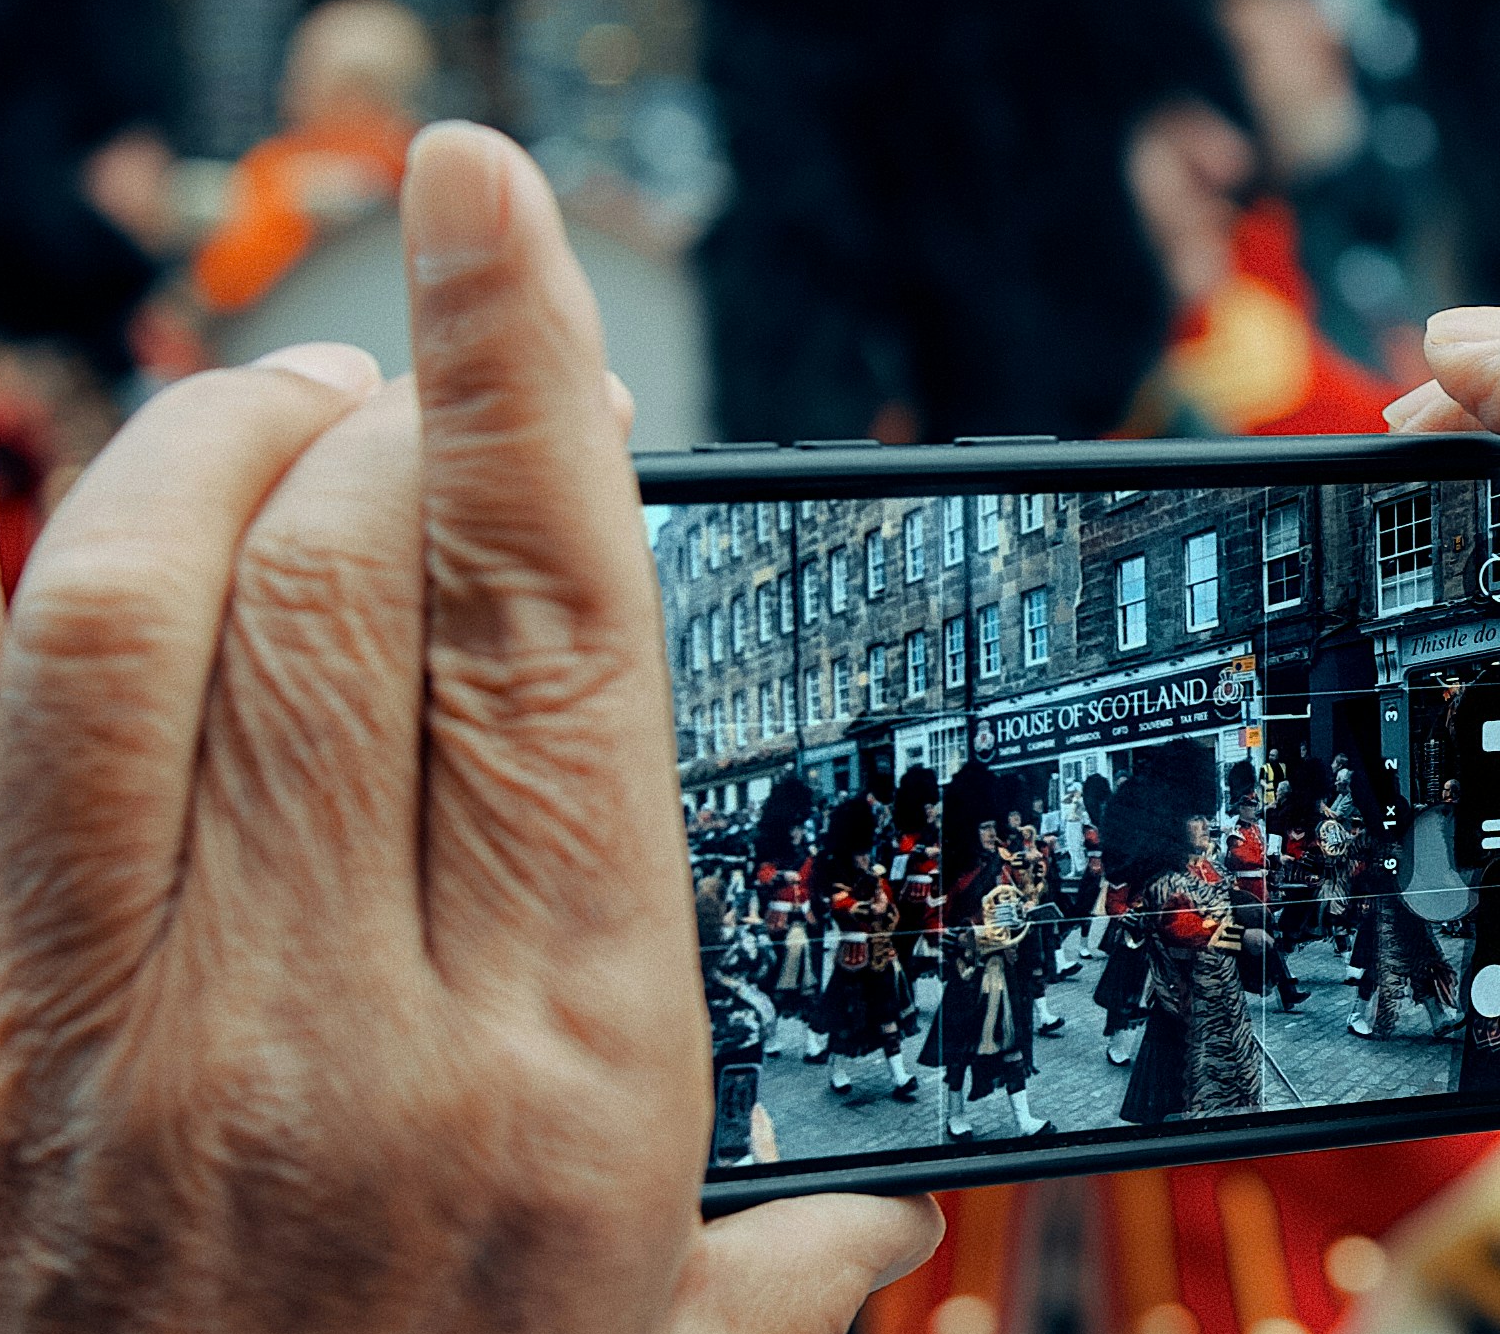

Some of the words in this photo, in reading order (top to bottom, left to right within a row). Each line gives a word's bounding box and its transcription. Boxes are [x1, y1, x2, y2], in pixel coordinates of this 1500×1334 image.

[1411, 629, 1467, 656] Thistle
[1474, 624, 1496, 644] do
[997, 710, 1055, 742] HOUSE
[1058, 703, 1084, 730] OF
[1088, 678, 1207, 725] SCOTLAND
[1385, 710, 1398, 722] 3
[1385, 758, 1398, 769] 2
[1384, 858, 1397, 874] .6
